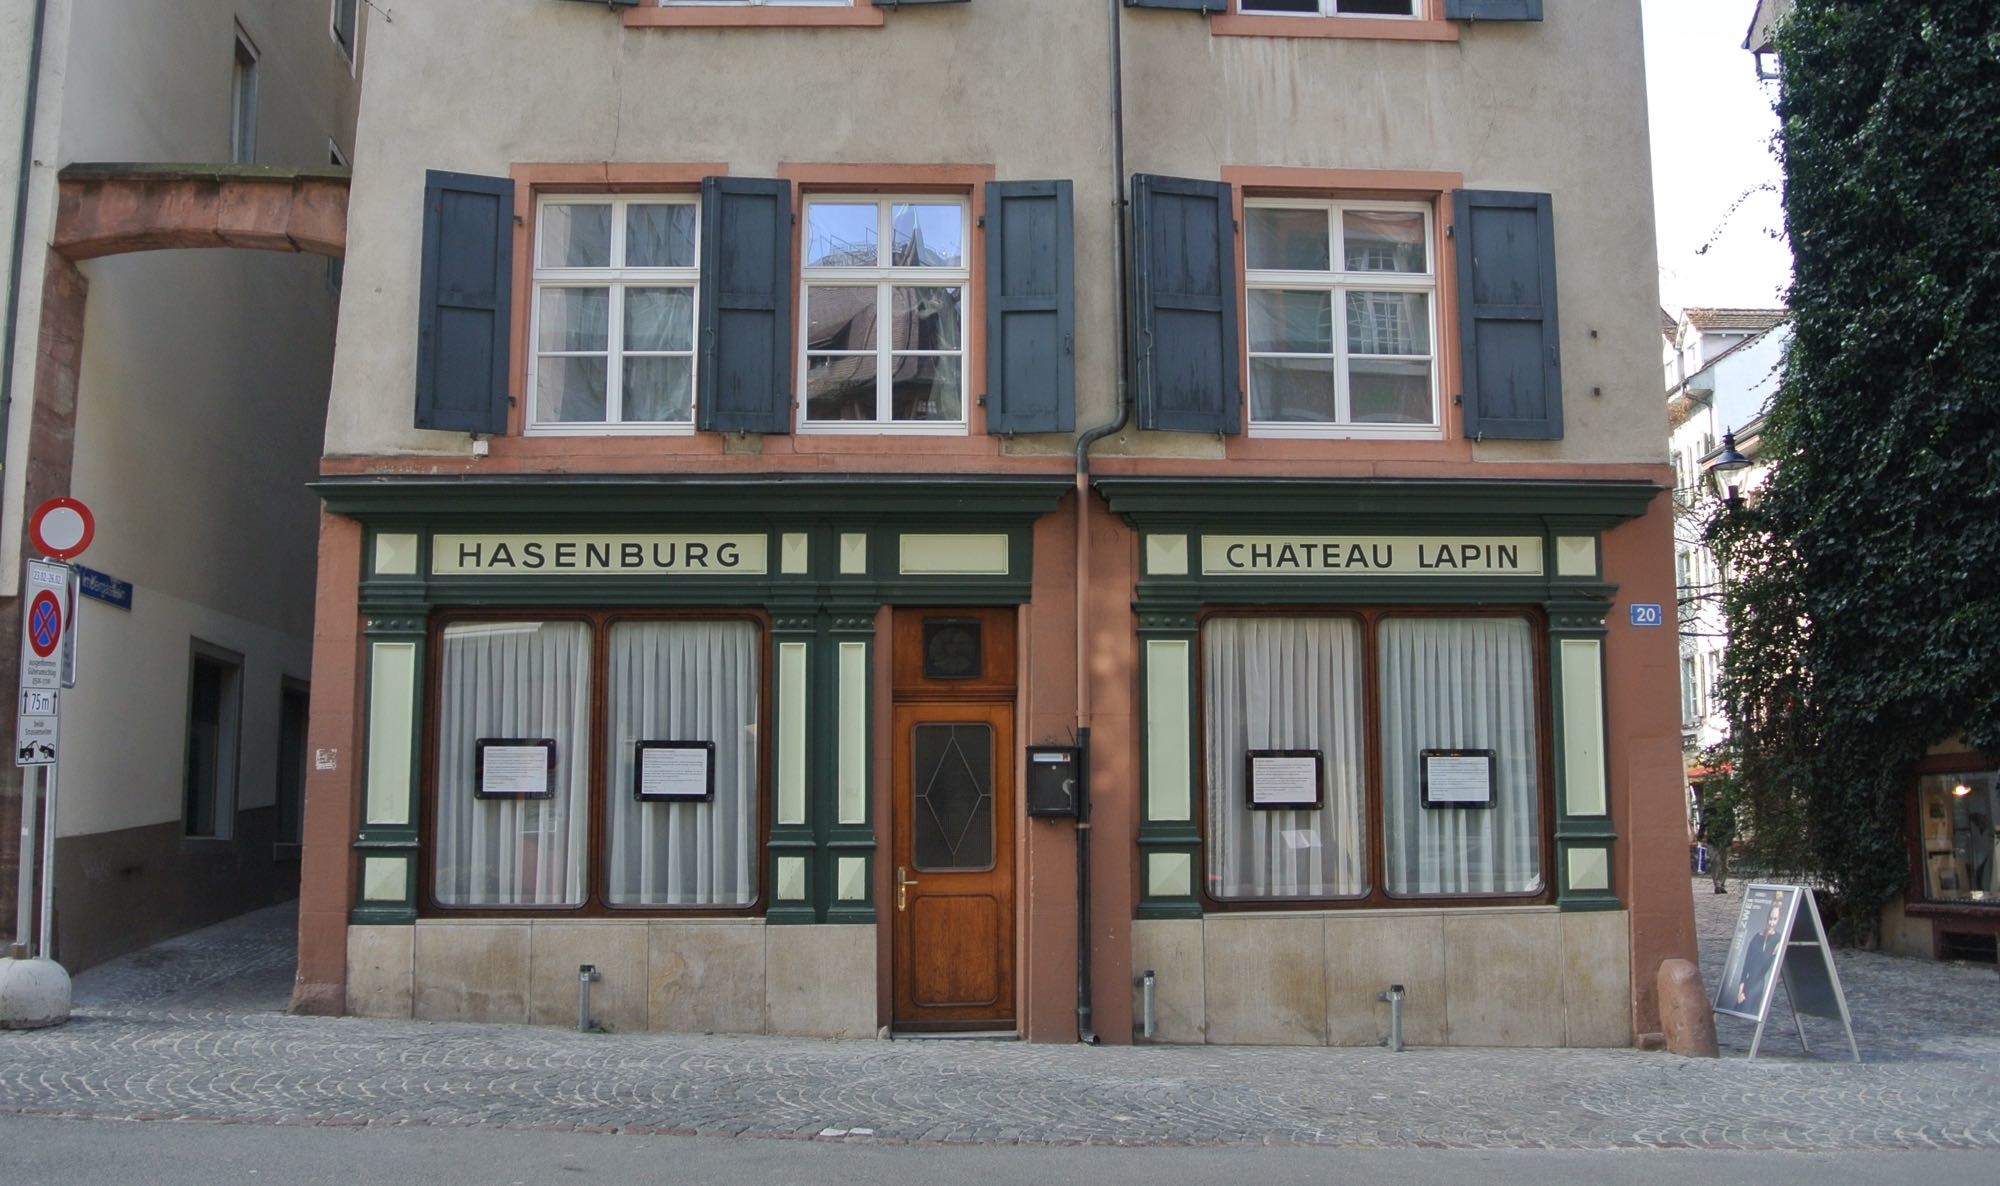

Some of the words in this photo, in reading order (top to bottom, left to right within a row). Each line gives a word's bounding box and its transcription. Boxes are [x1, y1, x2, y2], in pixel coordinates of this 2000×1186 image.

[458, 542, 741, 569] HASENBURG
[1418, 544, 1518, 568] LAPIN
[1637, 607, 1656, 622] 20
[31, 693, 41, 711] 75
[41, 698, 50, 711] m
